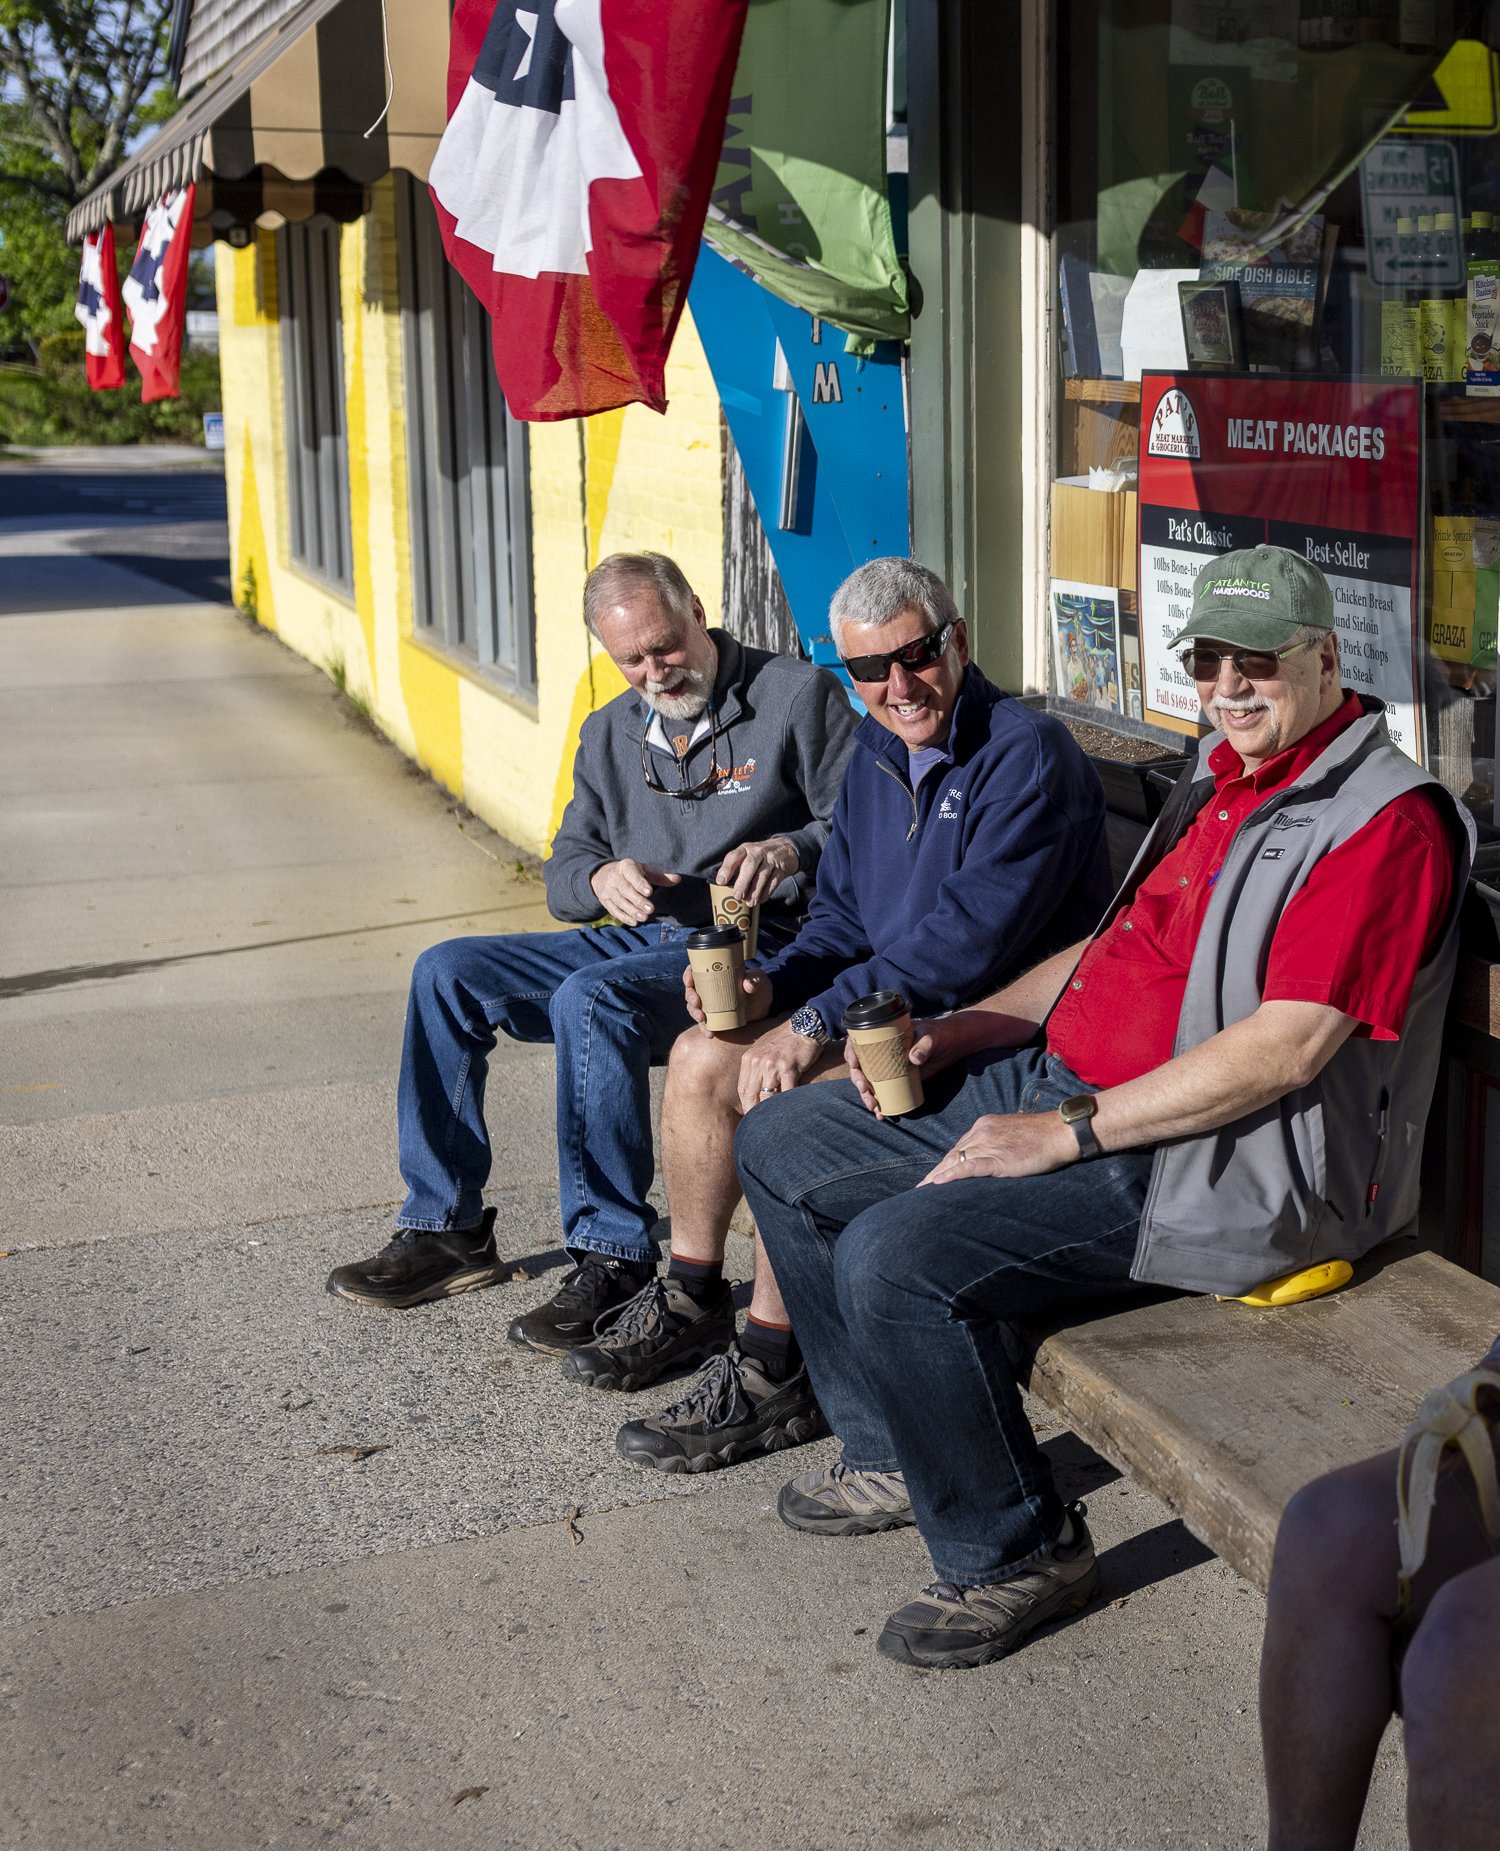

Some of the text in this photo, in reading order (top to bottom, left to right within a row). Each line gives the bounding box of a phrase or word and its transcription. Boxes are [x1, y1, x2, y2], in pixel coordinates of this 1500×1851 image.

[1215, 266, 1311, 285] SIDE DISH BIBLE
[1156, 433, 1170, 443] MEAT
[1227, 418, 1385, 461] MEAT PACKAGES
[1168, 517, 1233, 549] Pat’s Classic
[1305, 536, 1370, 570] Best-Seller
[1153, 557, 1198, 577] 10lbs Bone-In
[1156, 579, 1174, 595] 10lbs
[1213, 587, 1270, 600] HARDWOODS
[1215, 578, 1270, 591] ATLANTIC
[1335, 590, 1394, 612] Chicken Breast
[1168, 604, 1185, 620] 10lbs
[1352, 616, 1379, 635] Sirloin
[1432, 623, 1466, 648] GRAZA
[1344, 641, 1389, 663] Pork Chops
[1159, 667, 1173, 684] 5lbs
[1352, 668, 1374, 685] Steak
[1156, 688, 1198, 713] Full $169.95
[672, 735, 689, 757] R
